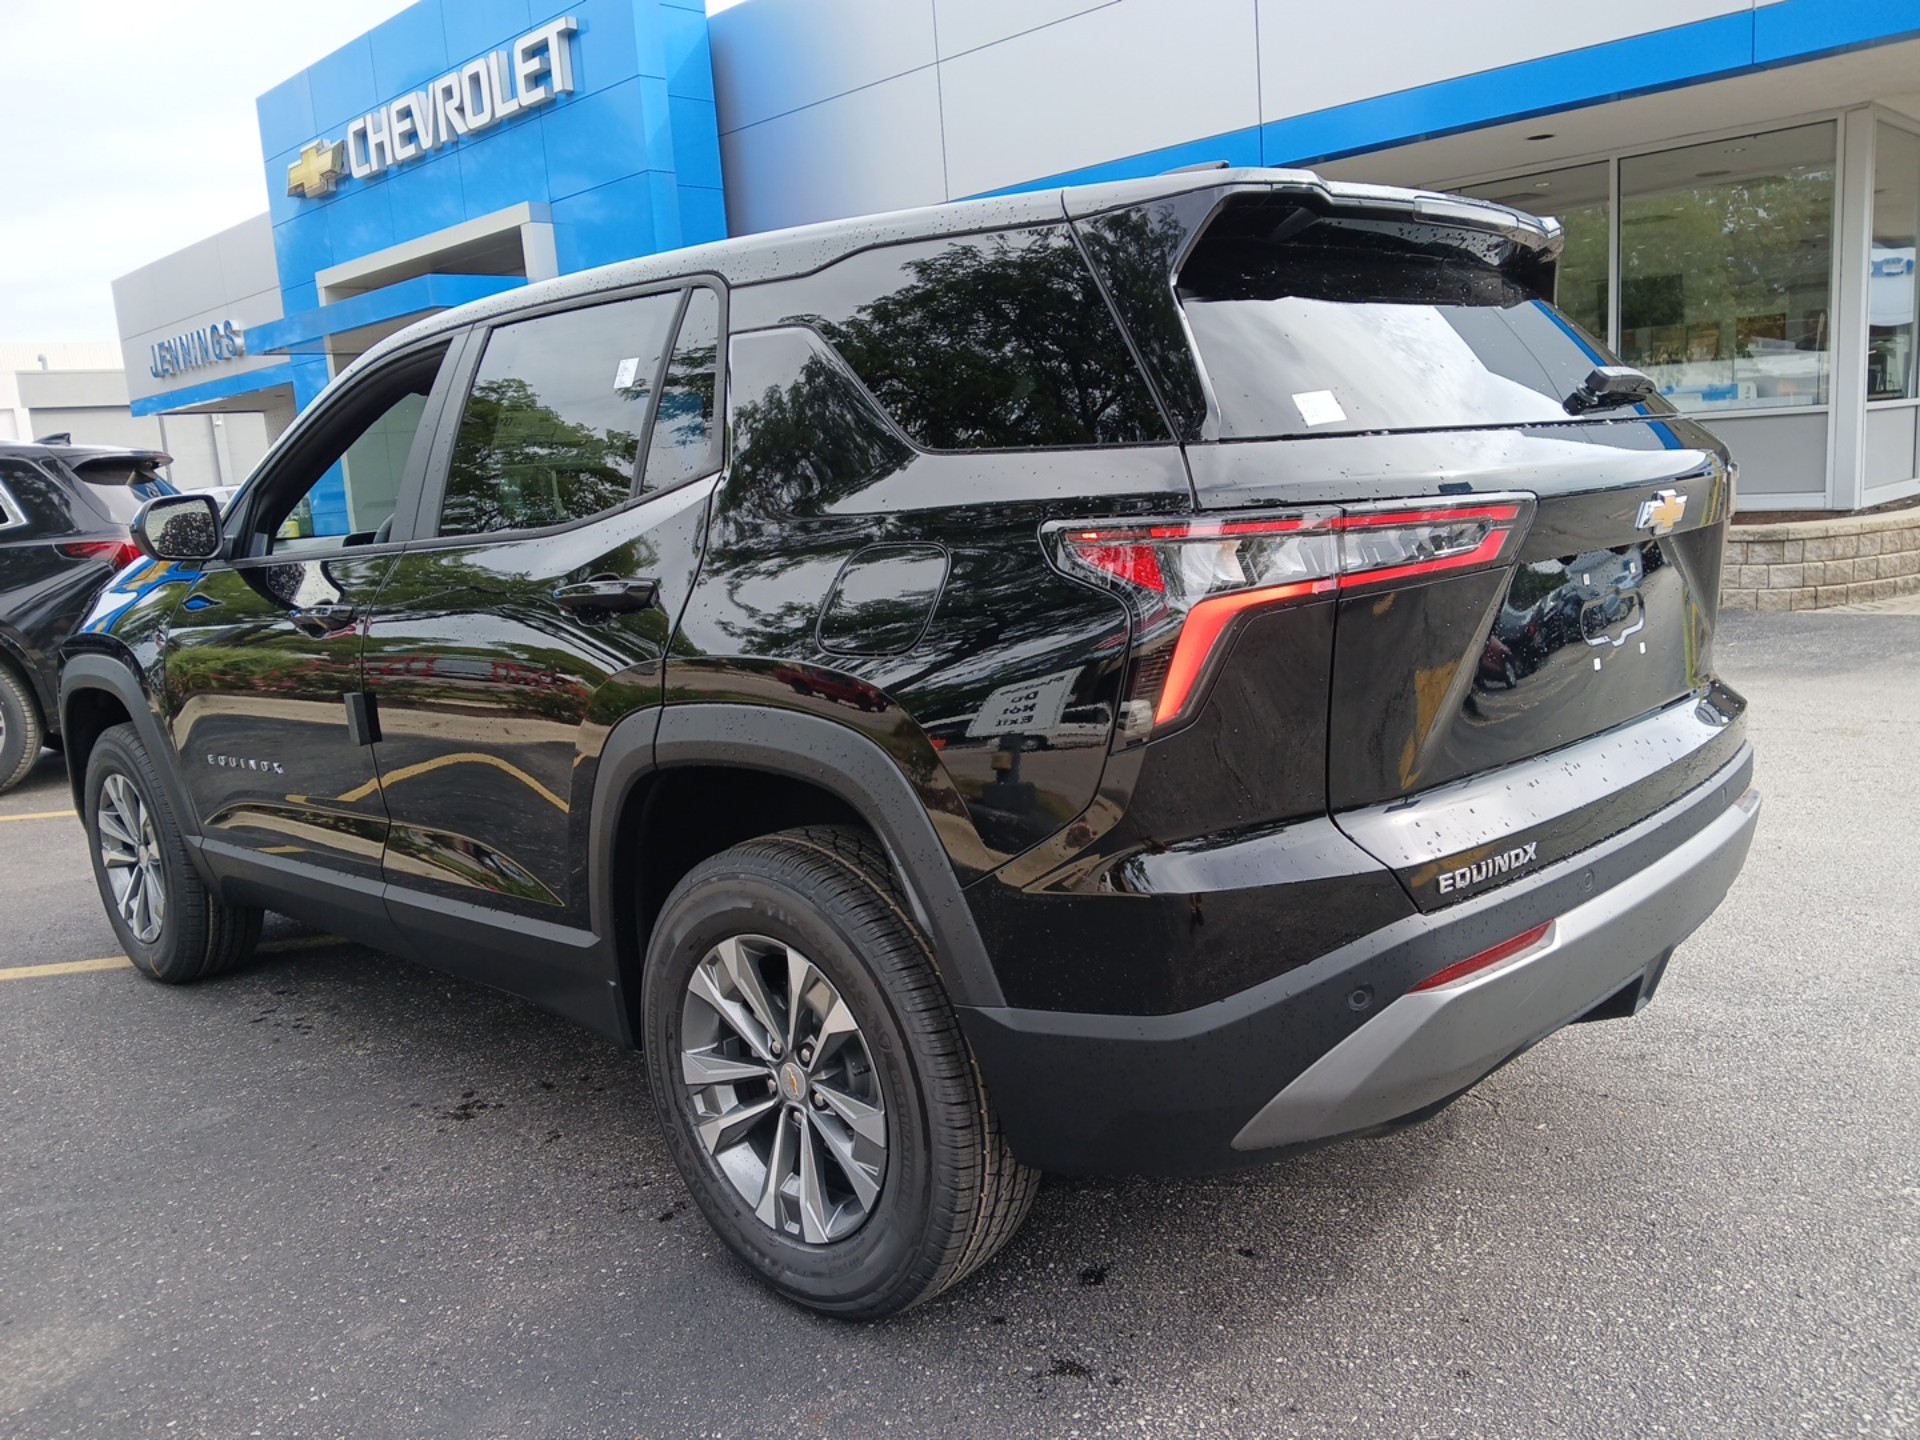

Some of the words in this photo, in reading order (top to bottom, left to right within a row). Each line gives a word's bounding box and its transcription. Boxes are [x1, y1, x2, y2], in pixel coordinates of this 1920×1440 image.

[347, 16, 577, 179] CHEVROLET
[150, 319, 242, 378] JENNINGS
[207, 753, 284, 775] EQUINOX
[1438, 841, 1537, 894] EQUINOX
